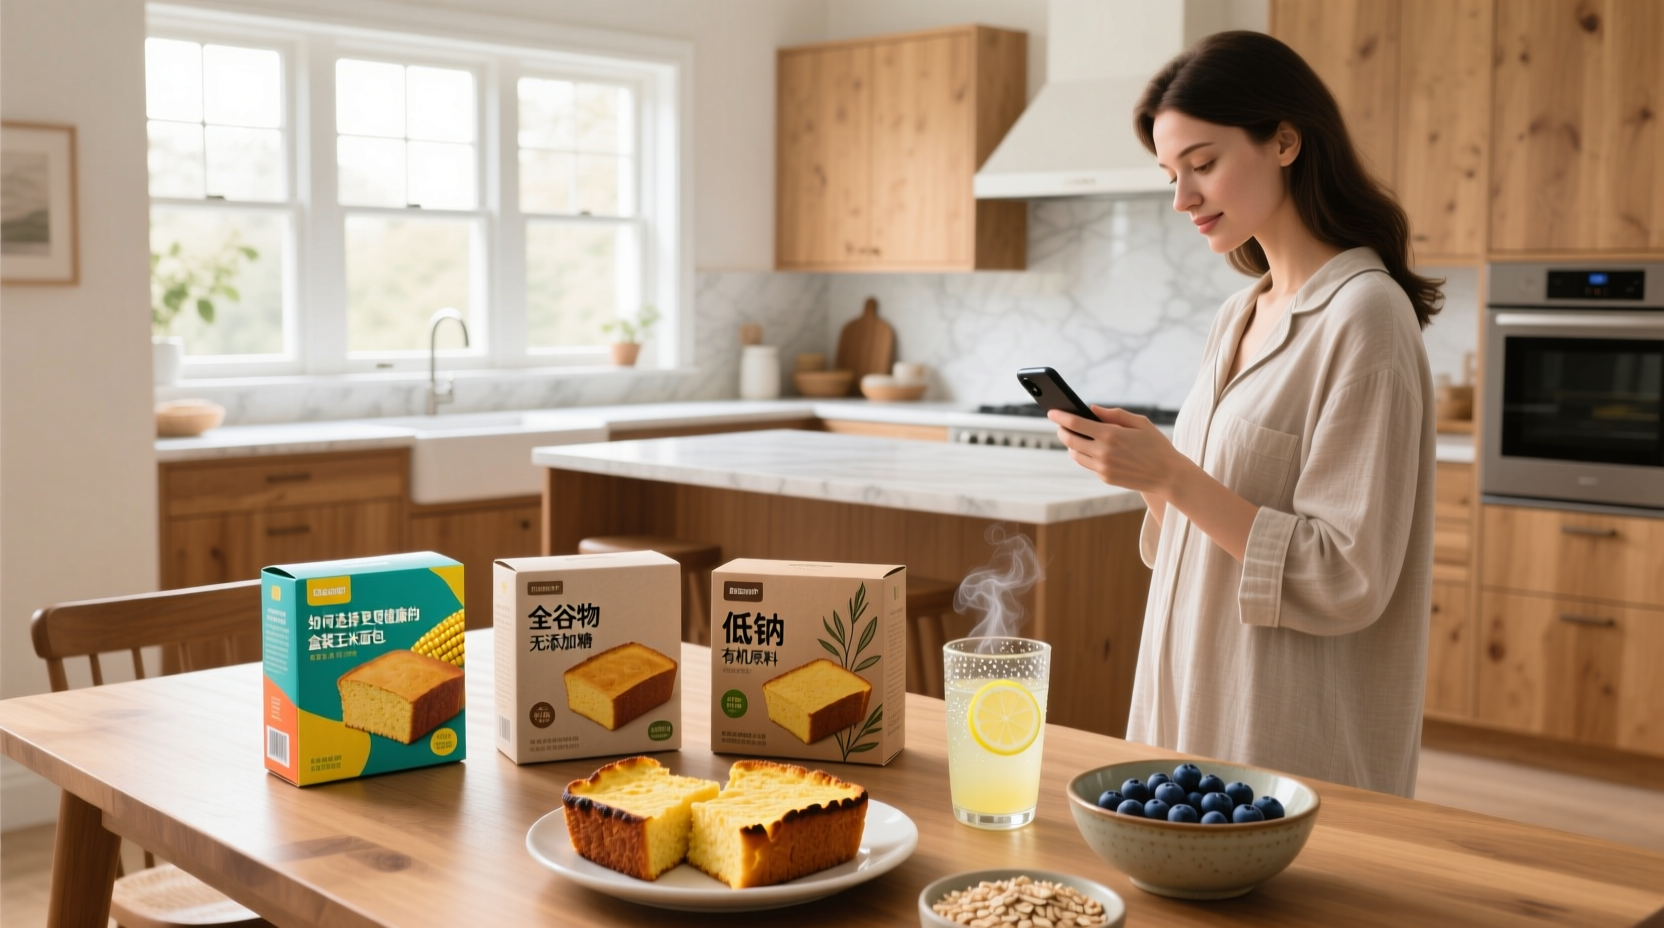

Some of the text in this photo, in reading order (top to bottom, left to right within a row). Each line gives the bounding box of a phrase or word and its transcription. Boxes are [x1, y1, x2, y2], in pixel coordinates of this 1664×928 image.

[528, 603, 601, 630] 全谷物
[722, 611, 785, 646] 低钠
[530, 632, 593, 652] 无添加糖
[722, 647, 778, 667] 有机原料
